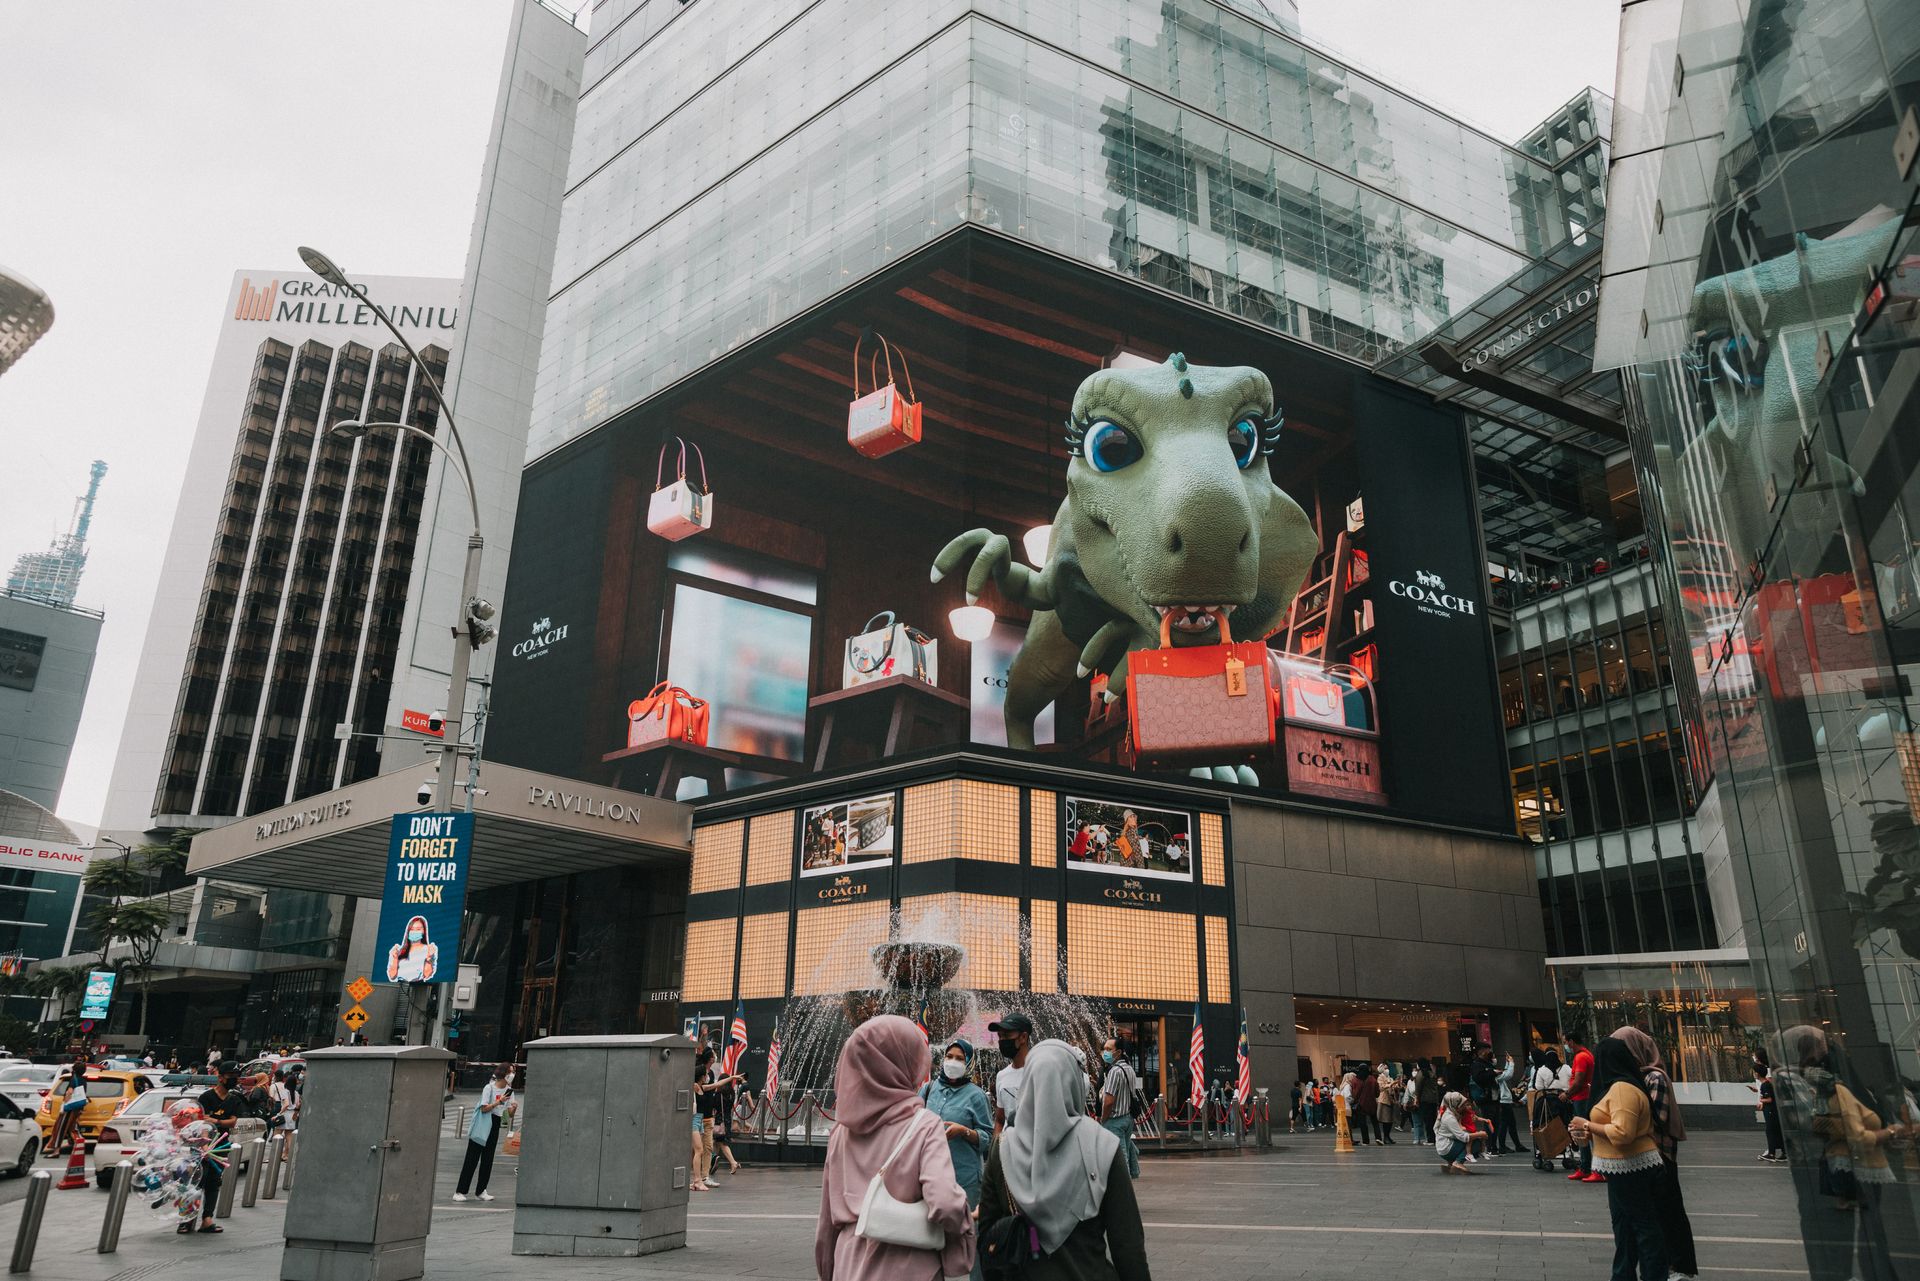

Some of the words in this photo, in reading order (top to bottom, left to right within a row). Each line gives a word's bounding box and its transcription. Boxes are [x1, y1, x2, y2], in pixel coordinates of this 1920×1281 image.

[282, 280, 368, 299] GRAND
[1389, 580, 1476, 616] COACH
[1418, 605, 1433, 614] NEW
[1433, 609, 1451, 618] YORK
[512, 624, 569, 657] COACH
[1297, 751, 1371, 777] COACH
[528, 786, 641, 824] PAVILION
[256, 811, 307, 840] PAVILION
[308, 799, 352, 825] SUITES
[409, 816, 455, 836] DON'T
[38, 850, 84, 862] BANK
[400, 838, 459, 858] FORGET
[397, 862, 415, 881] TO
[417, 862, 457, 881] WEAR
[402, 885, 444, 904] MASK
[818, 884, 868, 899] COACH
[1103, 888, 1161, 903] COACH
[651, 992, 669, 1001] ELITE
[1117, 1002, 1155, 1011] COACH
[1259, 1022, 1281, 1034] COS
